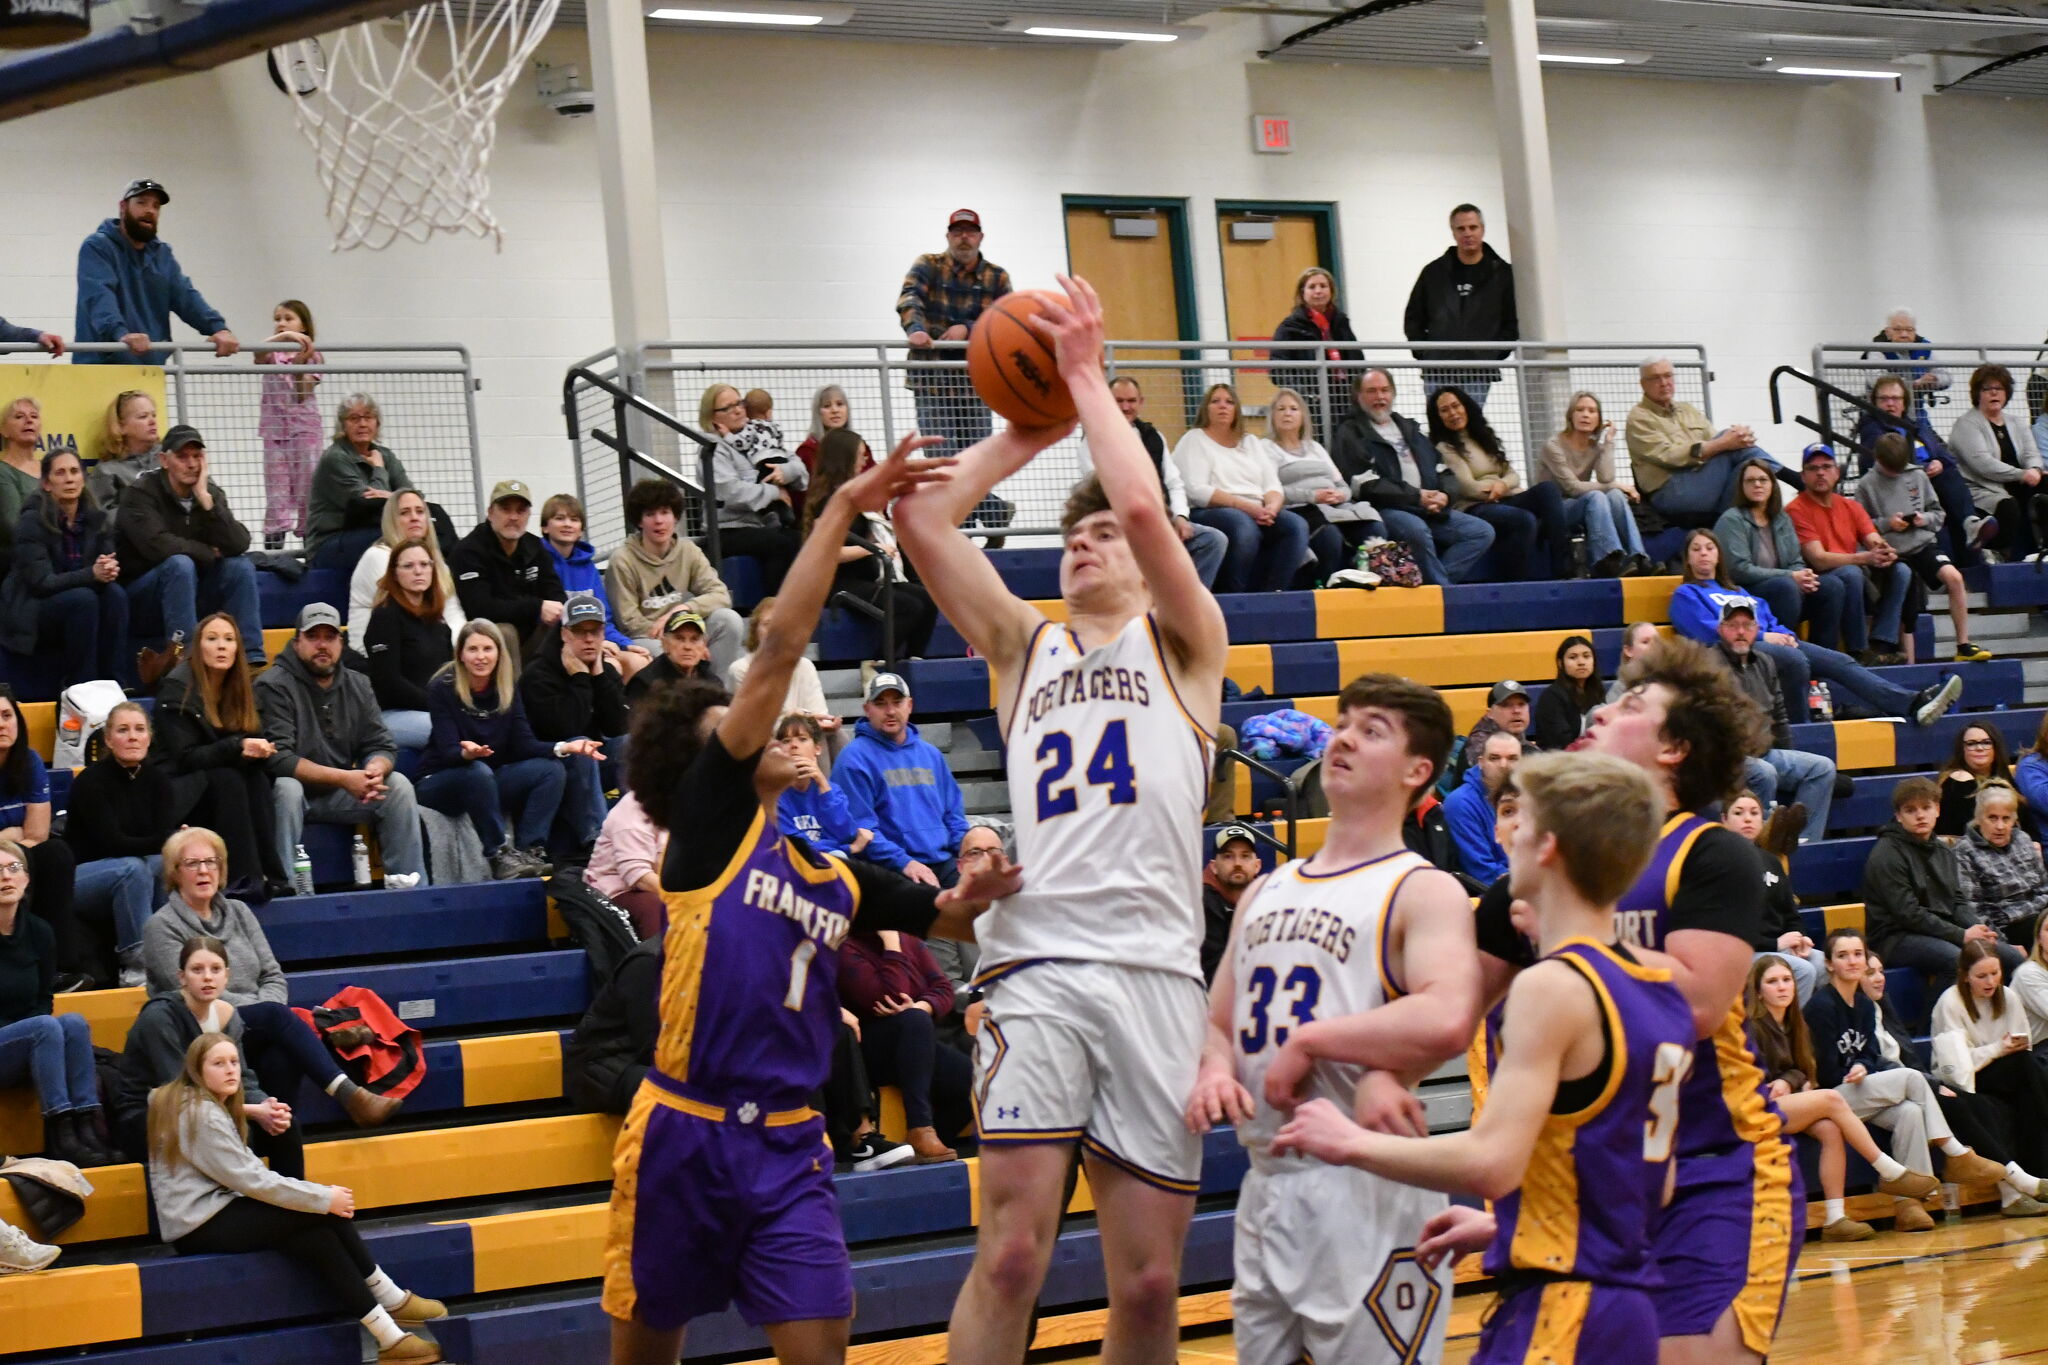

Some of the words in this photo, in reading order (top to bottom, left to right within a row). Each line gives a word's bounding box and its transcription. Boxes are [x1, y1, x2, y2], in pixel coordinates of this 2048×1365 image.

[1264, 119, 1290, 147] EXIT
[1035, 718, 1138, 824] 24
[783, 938, 817, 1012] 1
[1240, 964, 1322, 1055] 33
